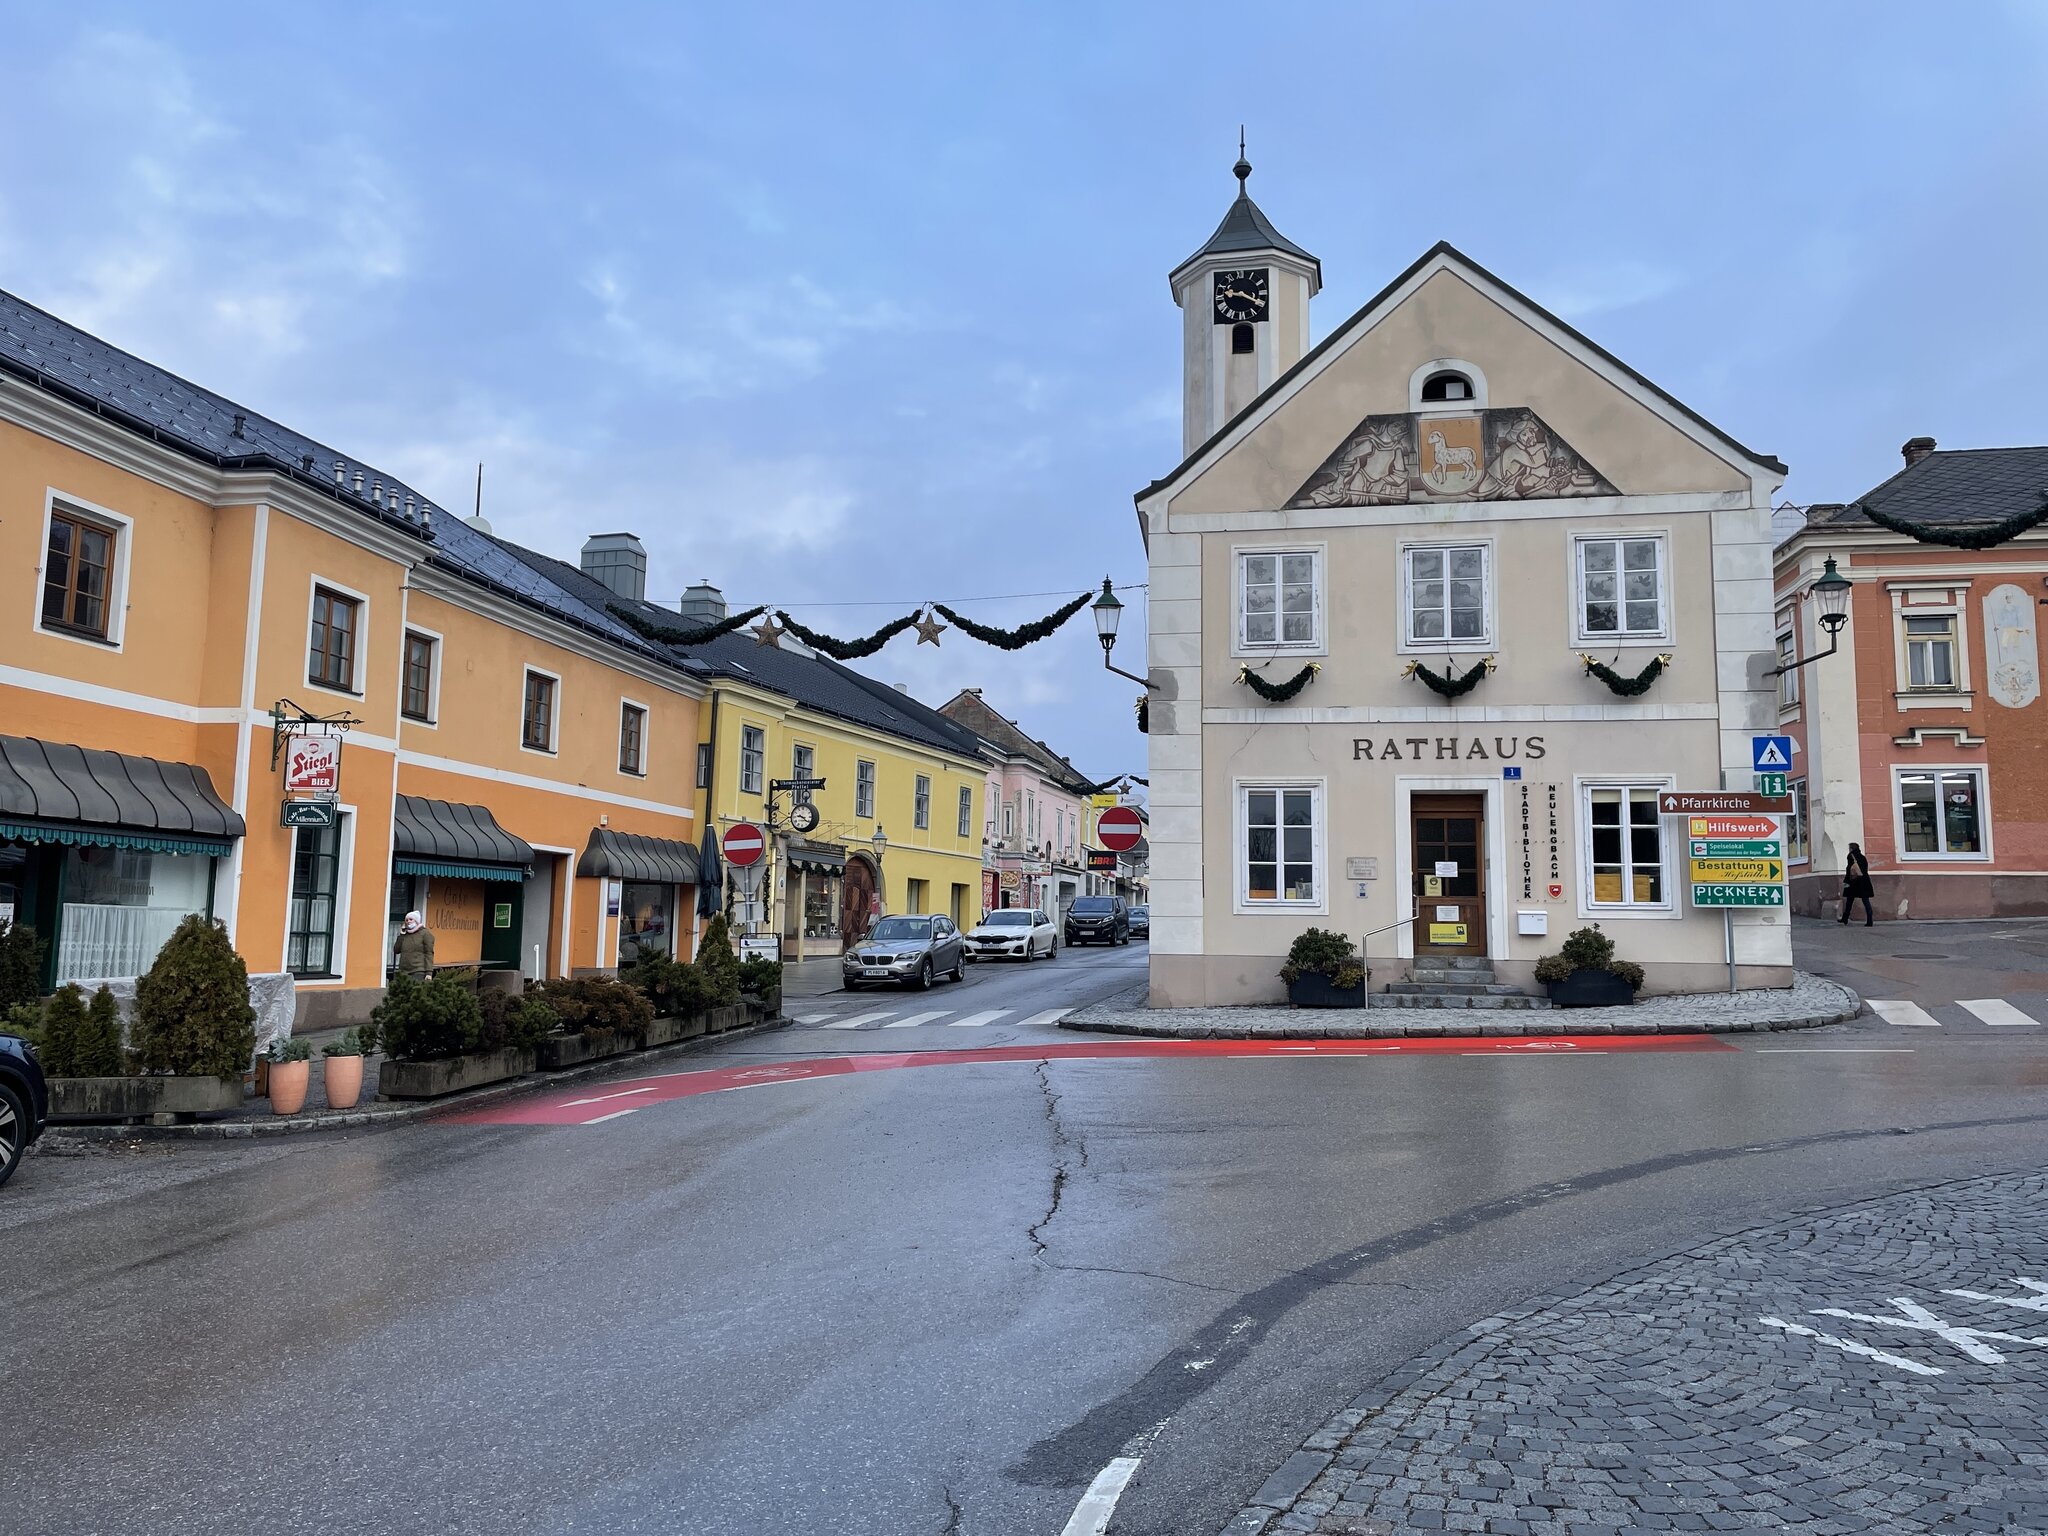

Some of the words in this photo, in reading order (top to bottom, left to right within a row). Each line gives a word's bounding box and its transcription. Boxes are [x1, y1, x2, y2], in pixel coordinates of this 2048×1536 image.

[1353, 737, 1546, 760] RATHAUS
[292, 751, 332, 778] Stiegl
[311, 778, 330, 786] BIER
[1681, 797, 1751, 809] Pfarrkirche
[1548, 785, 1558, 879] NEULENGBACH
[1708, 822, 1769, 832] Hilfswerk
[1522, 785, 1531, 899] STADTBIBLIOTHEK
[1698, 861, 1764, 872] Bestattung
[1696, 886, 1769, 897] PICKNER
